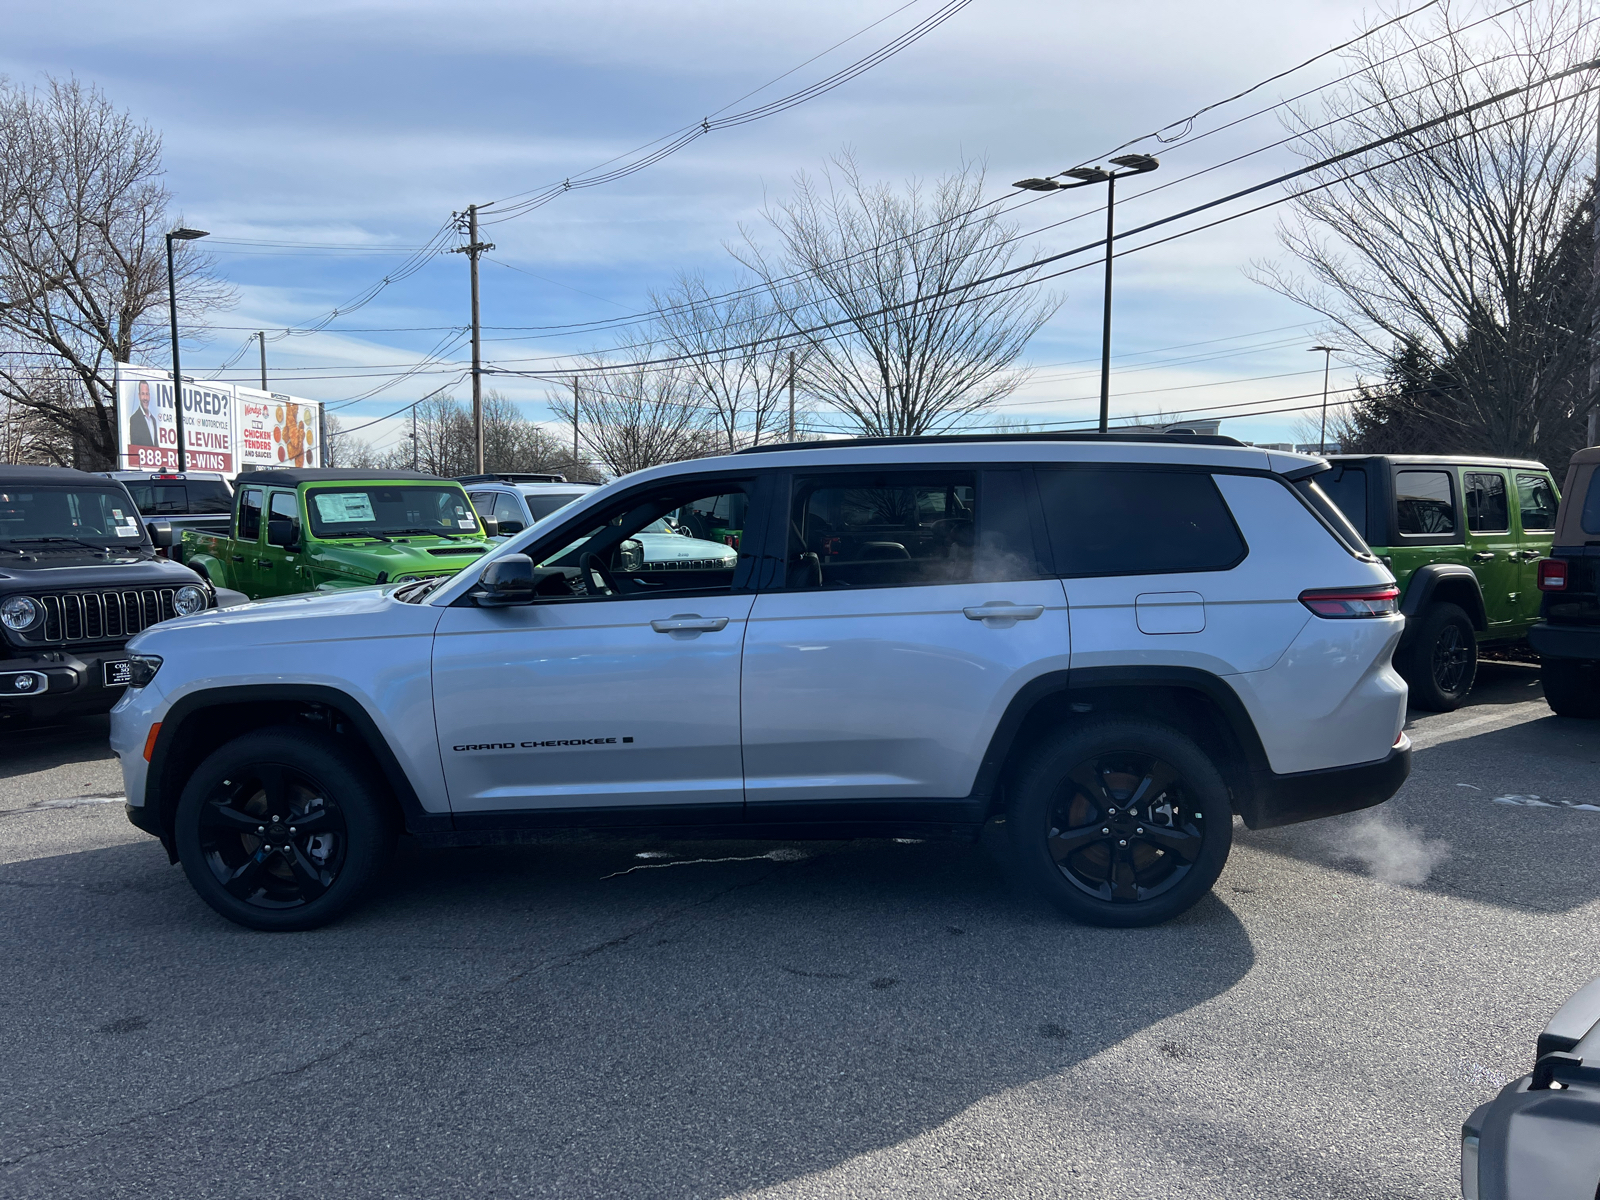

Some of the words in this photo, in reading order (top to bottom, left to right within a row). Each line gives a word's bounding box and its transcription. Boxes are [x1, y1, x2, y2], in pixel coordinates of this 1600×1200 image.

[156, 383, 228, 416] INURED?
[163, 413, 172, 423] CAR
[182, 416, 195, 426] RUCK
[202, 419, 228, 430] MOTORCYCLE
[159, 427, 178, 445] RO
[188, 430, 229, 449] LEVINE
[244, 428, 271, 440] CHICKEN
[244, 439, 271, 451] TENDERS
[255, 450, 272, 459] SAUCES
[452, 742, 516, 751] GRAND
[520, 737, 617, 748] CHEROKEE
